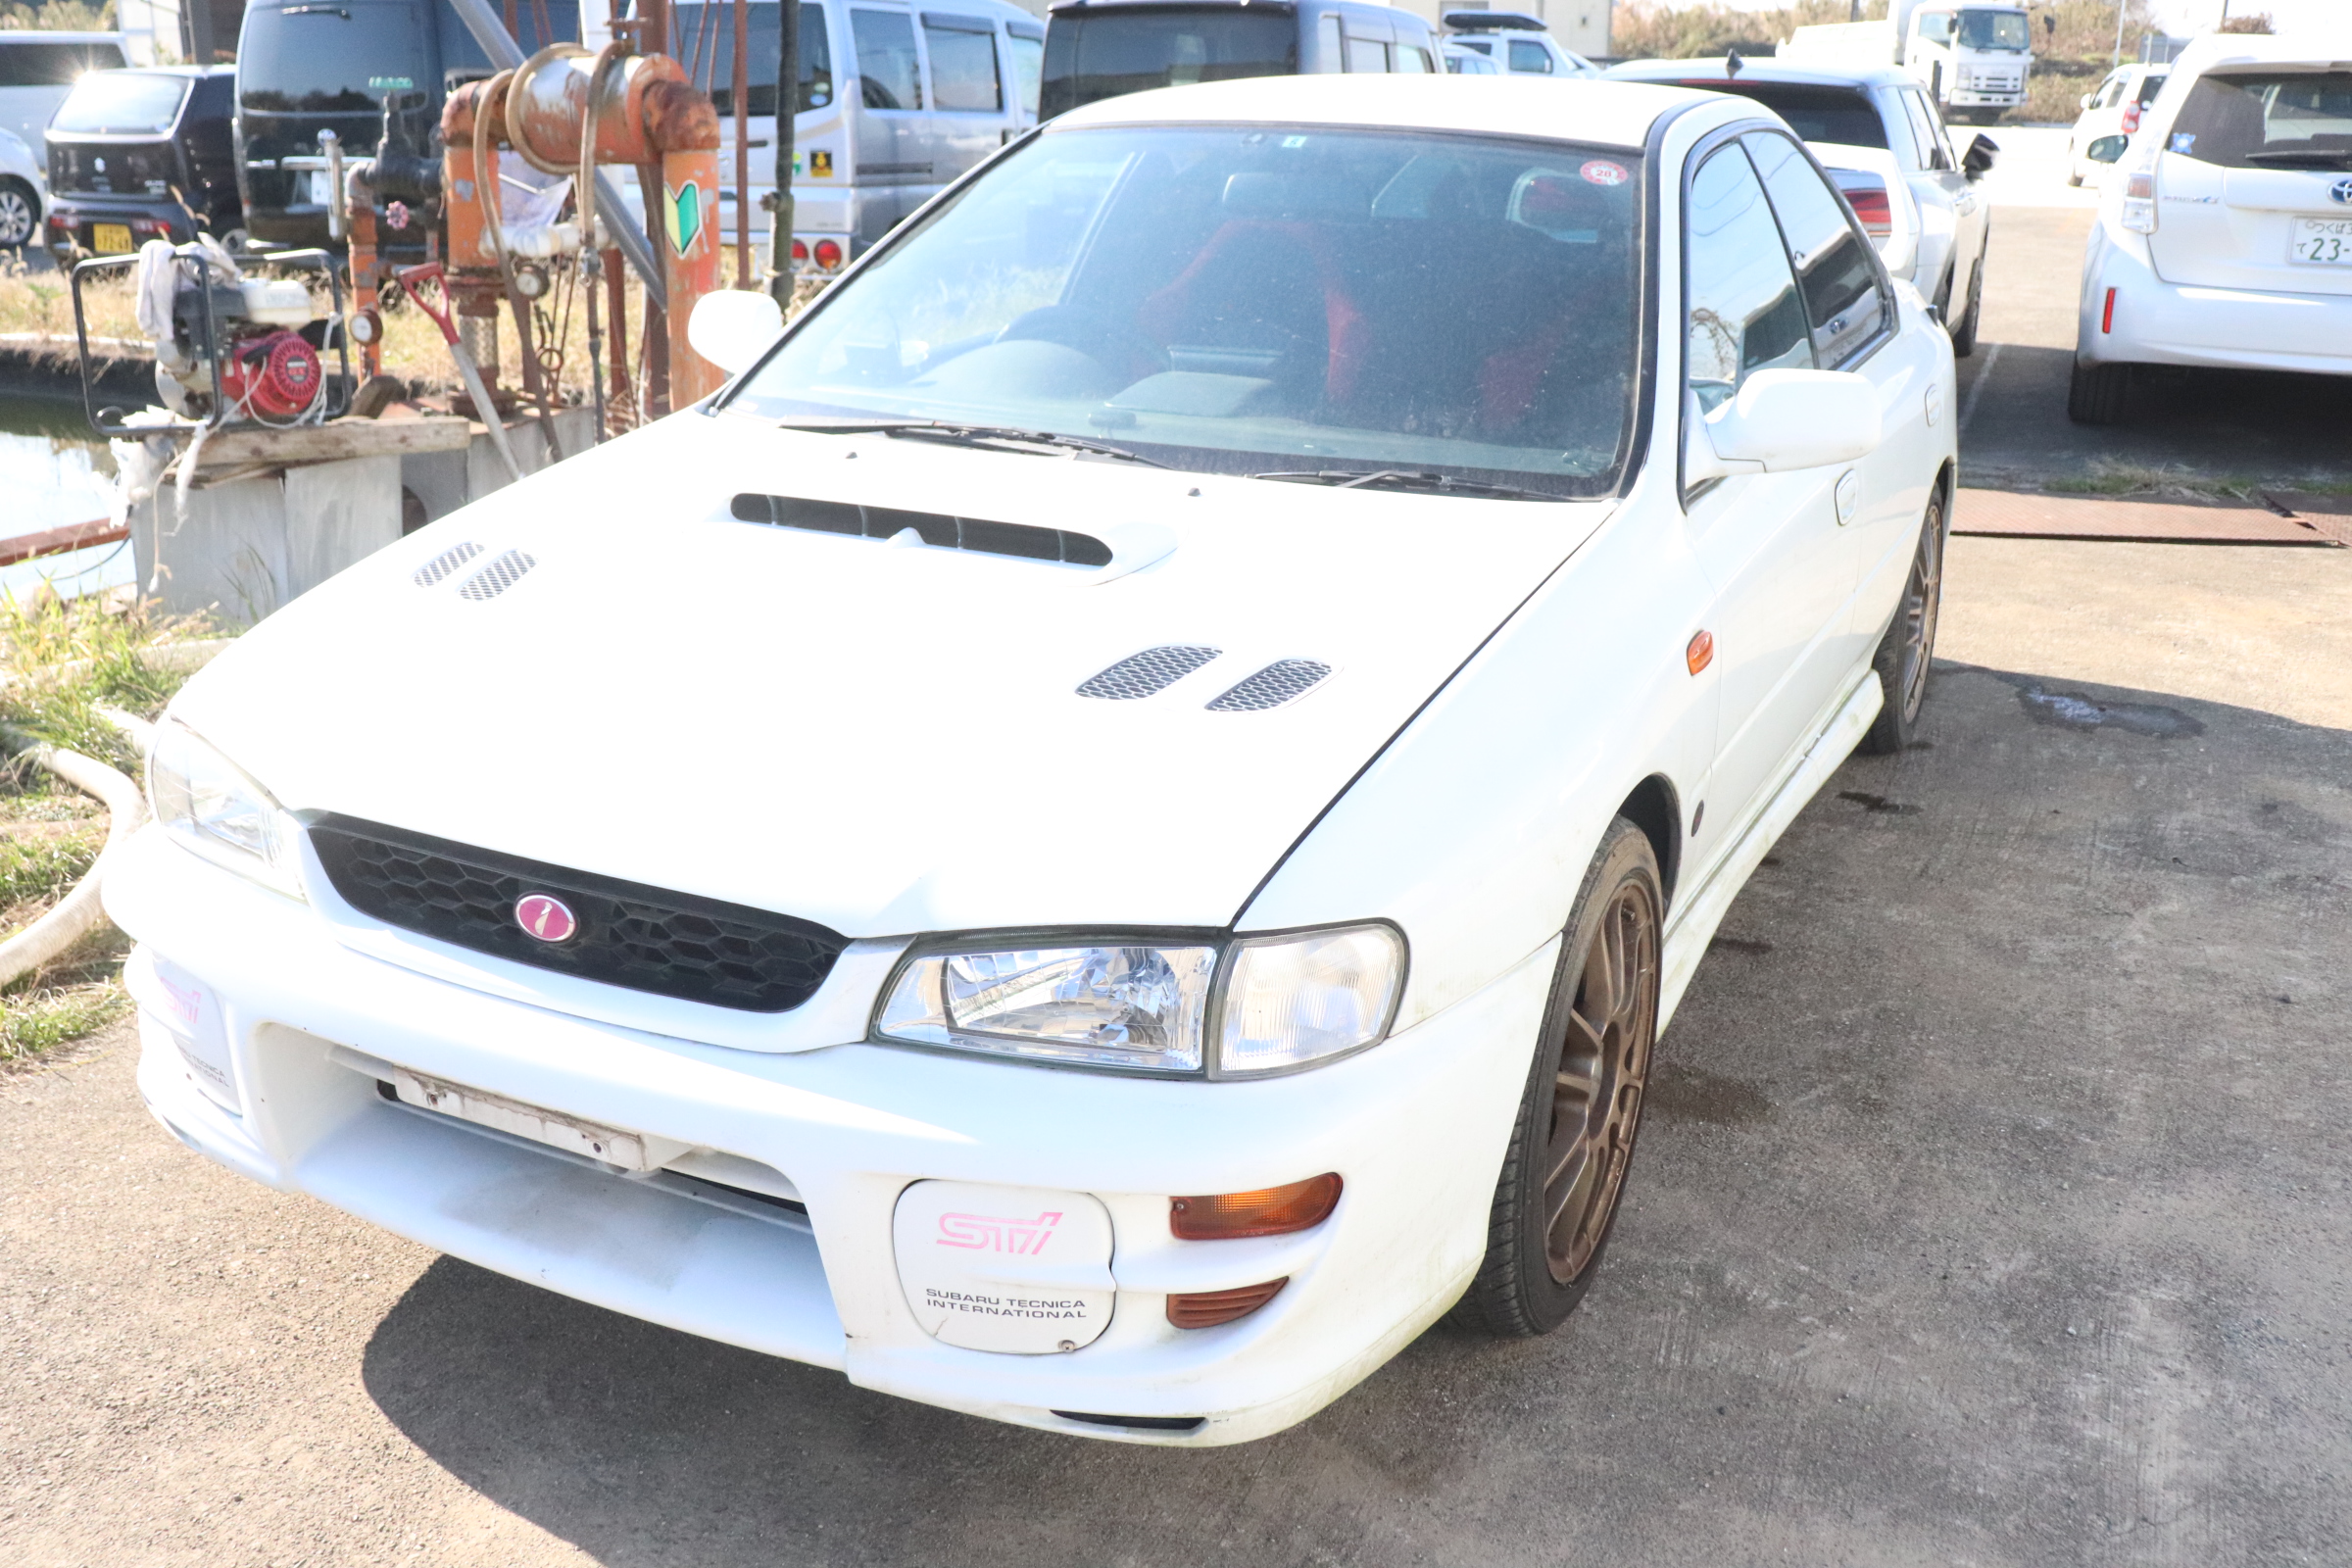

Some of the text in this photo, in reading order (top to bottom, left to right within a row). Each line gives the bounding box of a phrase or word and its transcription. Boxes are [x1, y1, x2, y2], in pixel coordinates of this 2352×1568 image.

[1595, 169, 1612, 177] 28
[926, 1288, 1086, 1308] SUBARU TECNICA
[926, 1298, 1087, 1319] INTERNATIONAL
